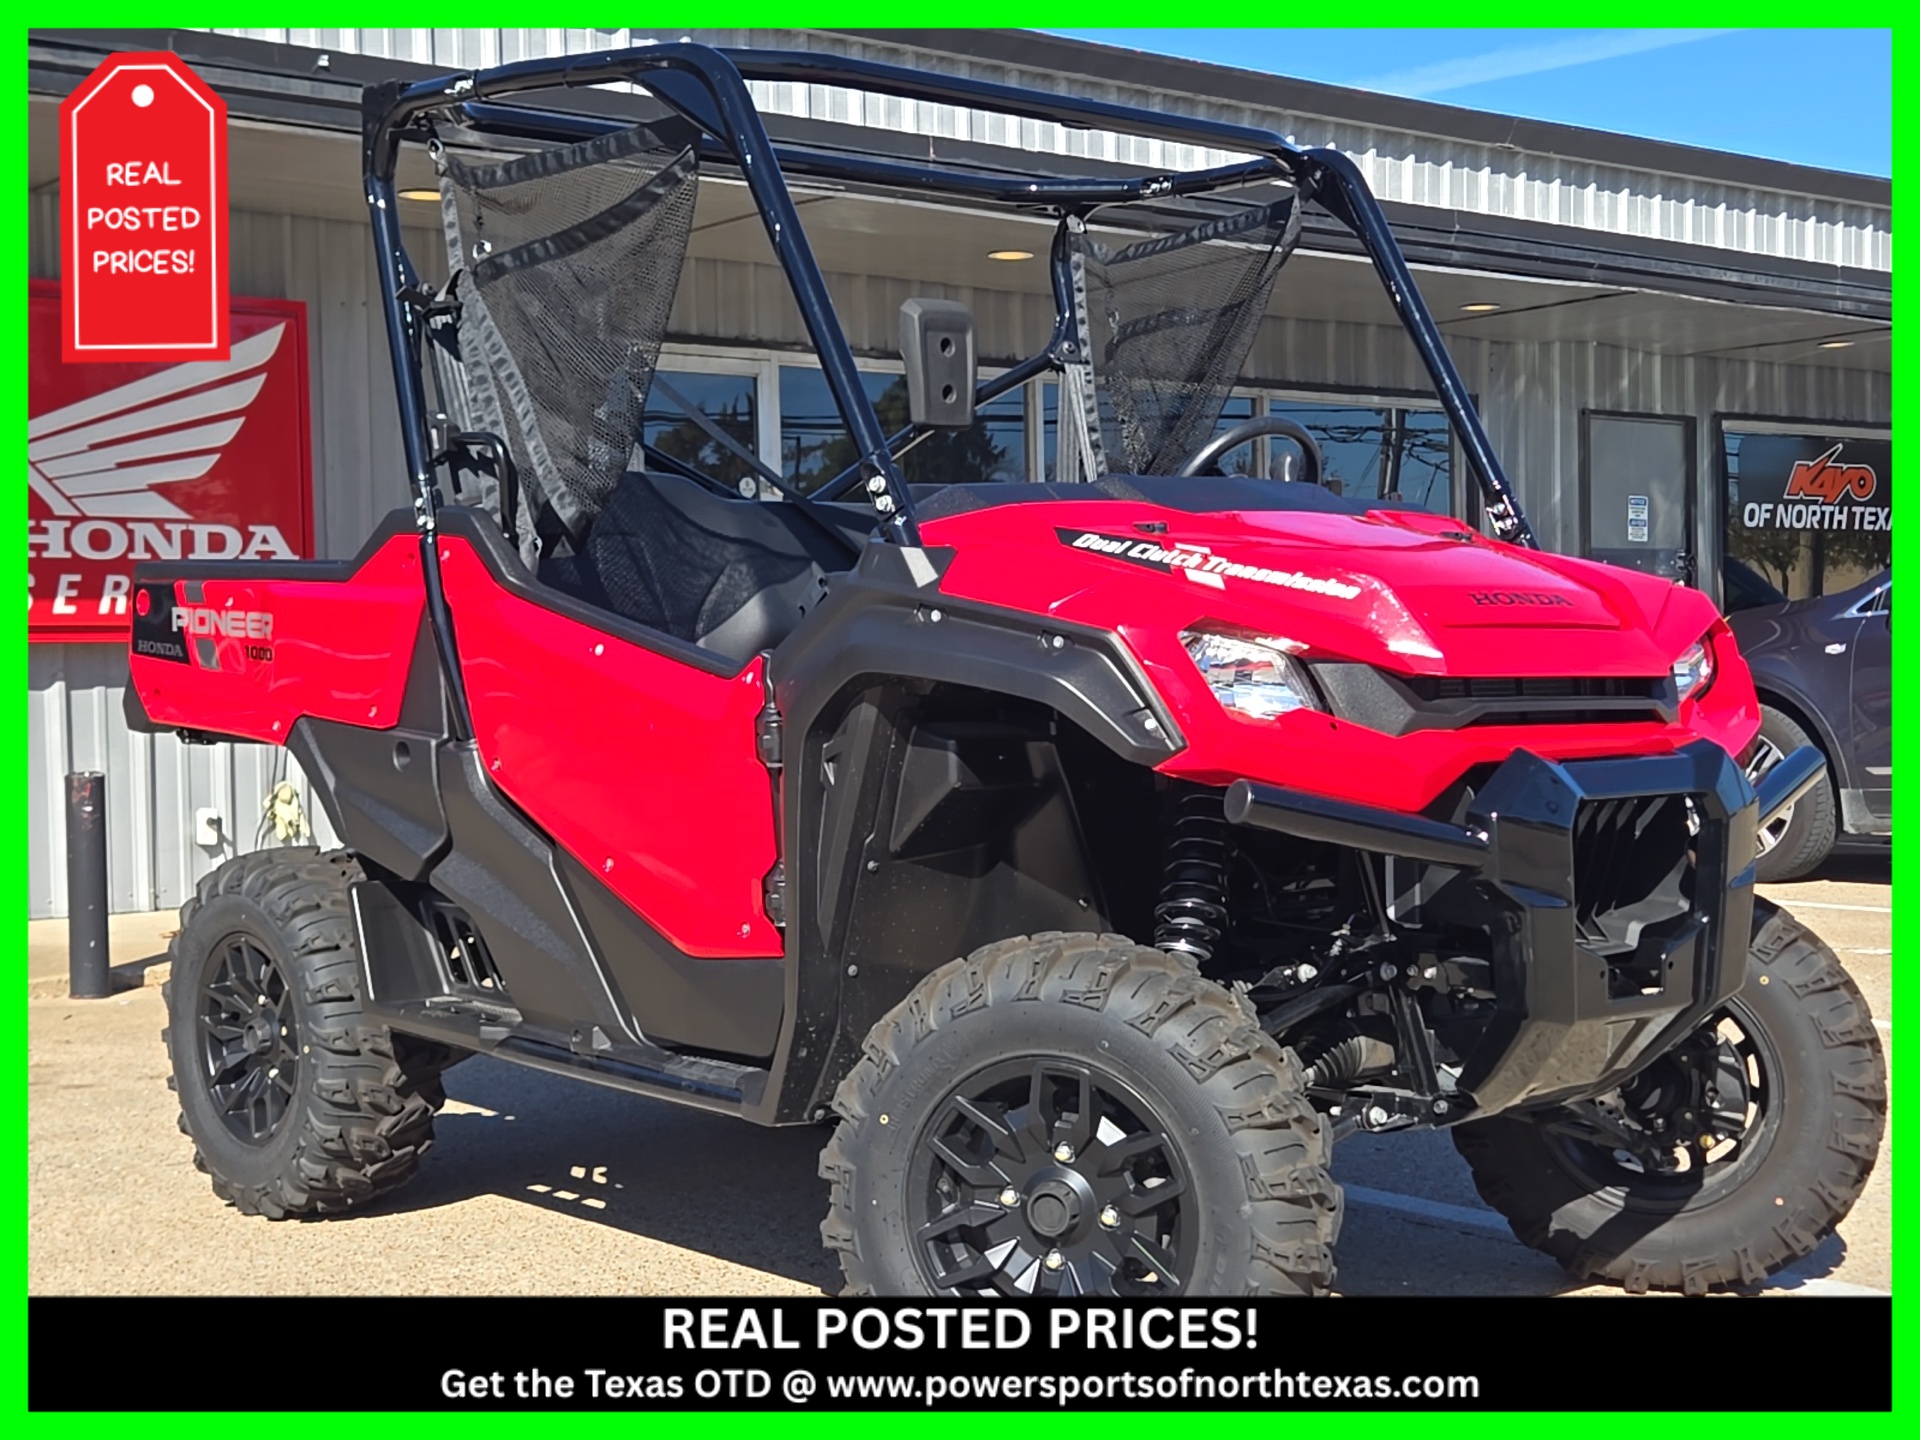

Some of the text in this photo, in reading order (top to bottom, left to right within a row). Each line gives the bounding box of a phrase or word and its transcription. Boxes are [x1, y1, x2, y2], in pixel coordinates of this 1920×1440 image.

[1783, 443, 1877, 506] KAYO
[1743, 502, 1892, 531] OF NORTH TEX
[28, 519, 300, 560] HONDA
[1072, 533, 1362, 600] Dual Clutch Transmission
[1468, 592, 1575, 607] HONDA
[171, 607, 273, 640] PIONEER
[138, 640, 184, 657] HONDA
[244, 645, 273, 662] 1000
